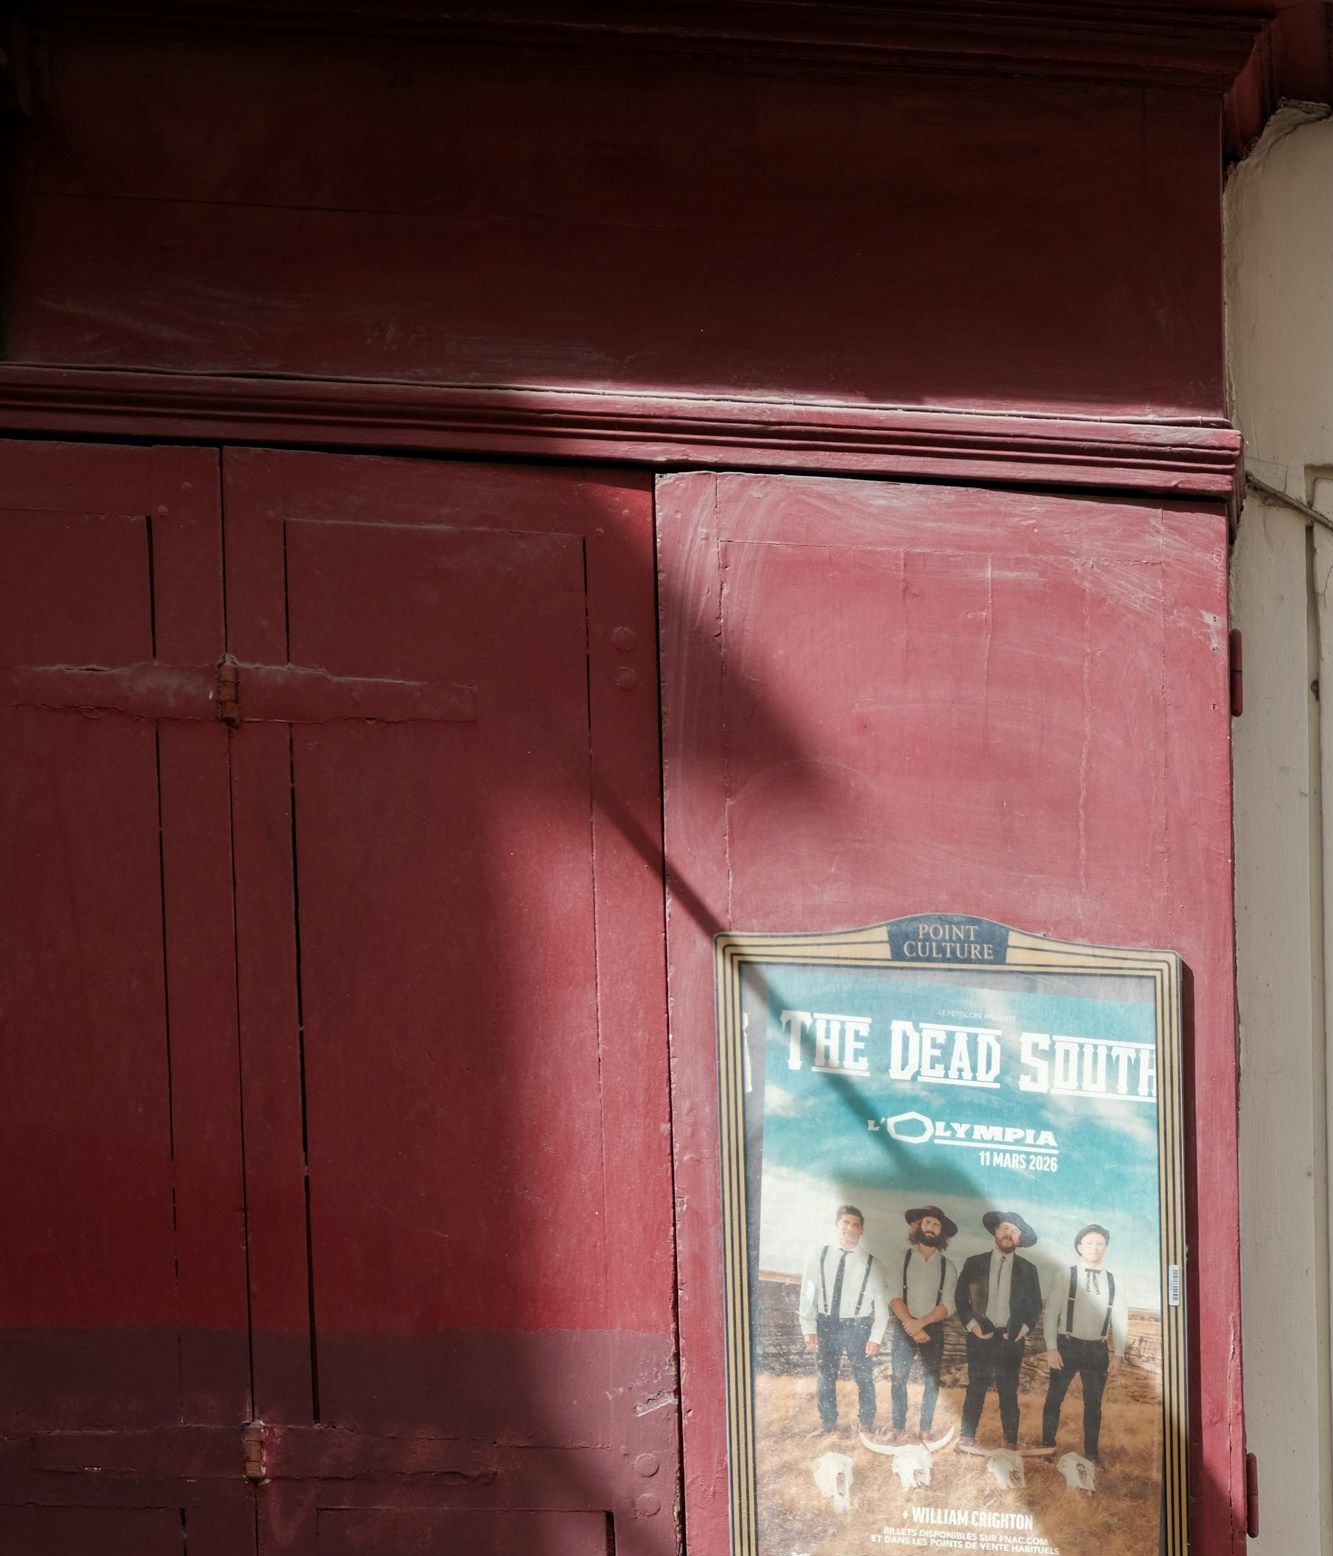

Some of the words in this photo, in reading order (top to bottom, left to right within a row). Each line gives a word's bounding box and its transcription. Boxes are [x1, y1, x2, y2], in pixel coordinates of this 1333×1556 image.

[918, 923, 979, 941] POINT
[903, 940, 994, 960] CULTURE
[780, 1010, 873, 1077] THE
[889, 1020, 1003, 1089] DEAD
[867, 1111, 1059, 1149] L'OLYMPIA
[979, 1150, 991, 1167] 11
[993, 1151, 1027, 1169] MARS
[1028, 1154, 1058, 1173] 2026
[912, 1506, 969, 1527] WILLIAM
[972, 1511, 1034, 1531] CRIGHTON
[870, 1535, 882, 1543] ET
[884, 1535, 910, 1545] DANS
[912, 1537, 928, 1546] LES
[930, 1538, 963, 1549] POINTS
[965, 1541, 978, 1550] DE
[980, 1542, 1010, 1552] VENTE
[1011, 1544, 1060, 1556] HABITUELS
[883, 1526, 917, 1537] BILLETS
[919, 1529, 977, 1541] DISPONIBLES
[979, 1534, 997, 1543] SUR
[999, 1535, 1048, 1546] FNAC.COM
